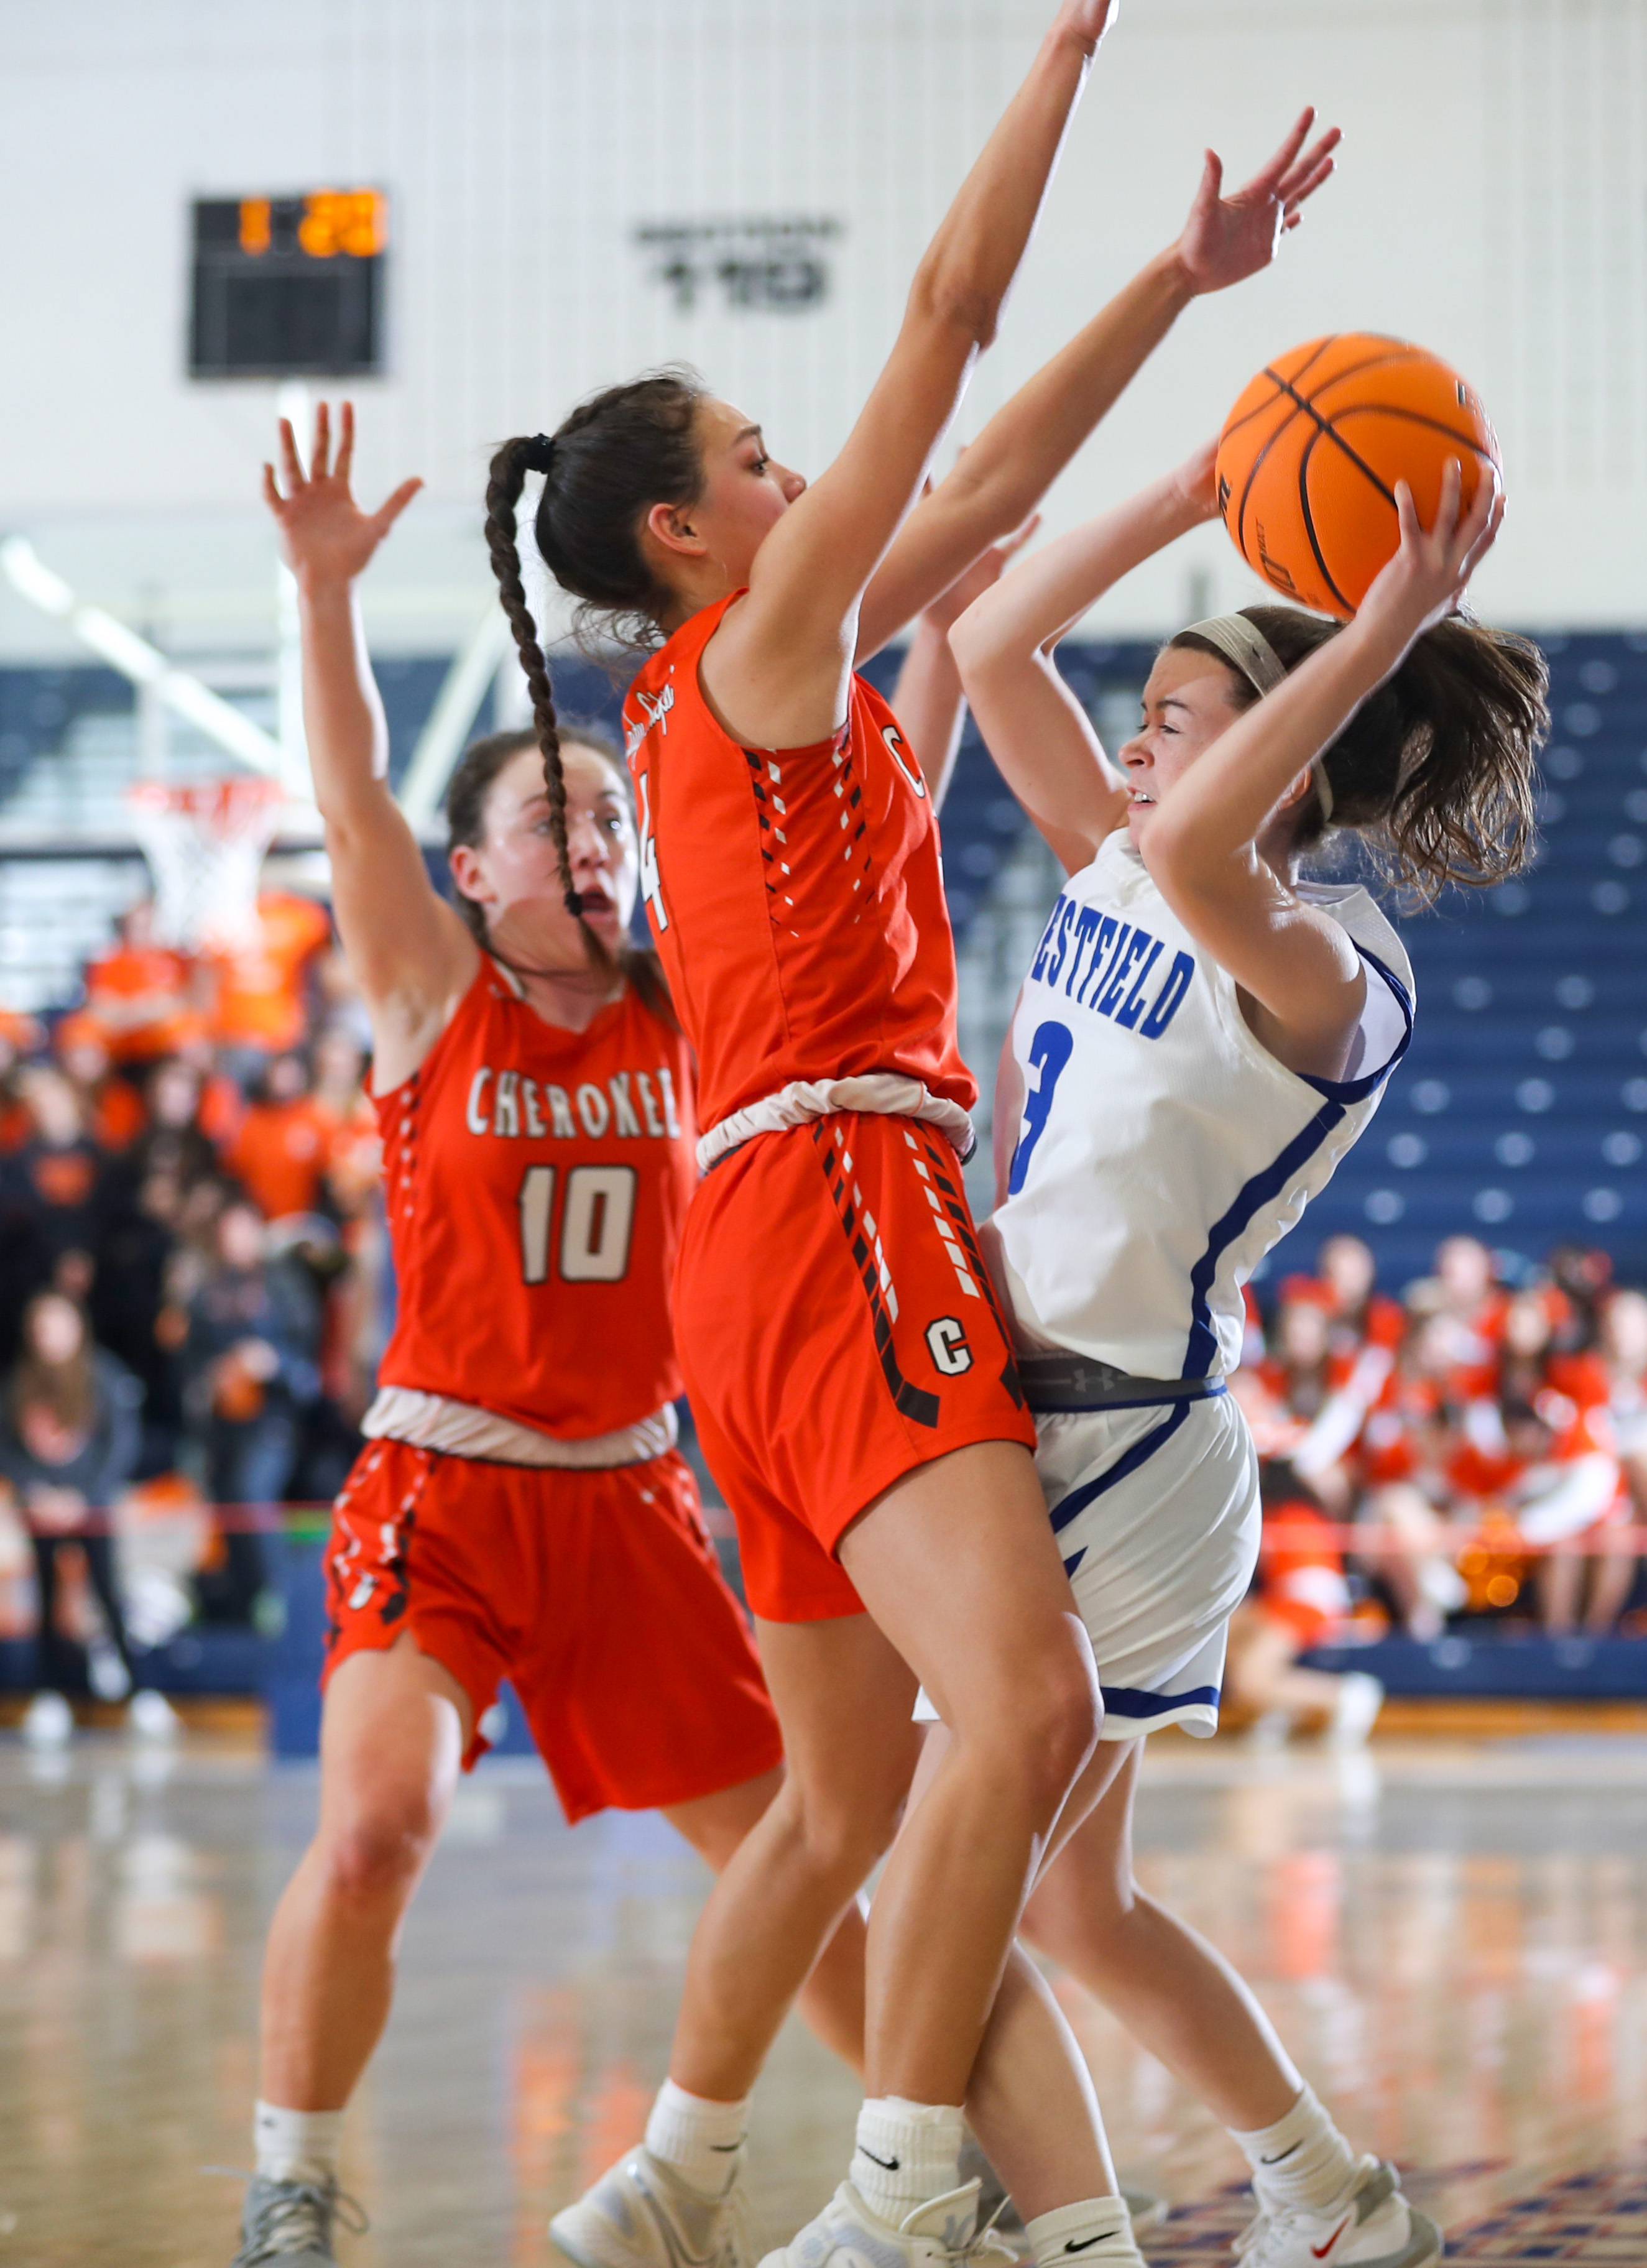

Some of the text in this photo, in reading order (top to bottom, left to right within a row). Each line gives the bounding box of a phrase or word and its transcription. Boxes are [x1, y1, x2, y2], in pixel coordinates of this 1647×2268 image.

[1031, 893, 1195, 1040] ESTFIELD
[1008, 1020, 1074, 1196] 3
[517, 1164, 637, 1286] 10
[923, 1315, 974, 1377] C
